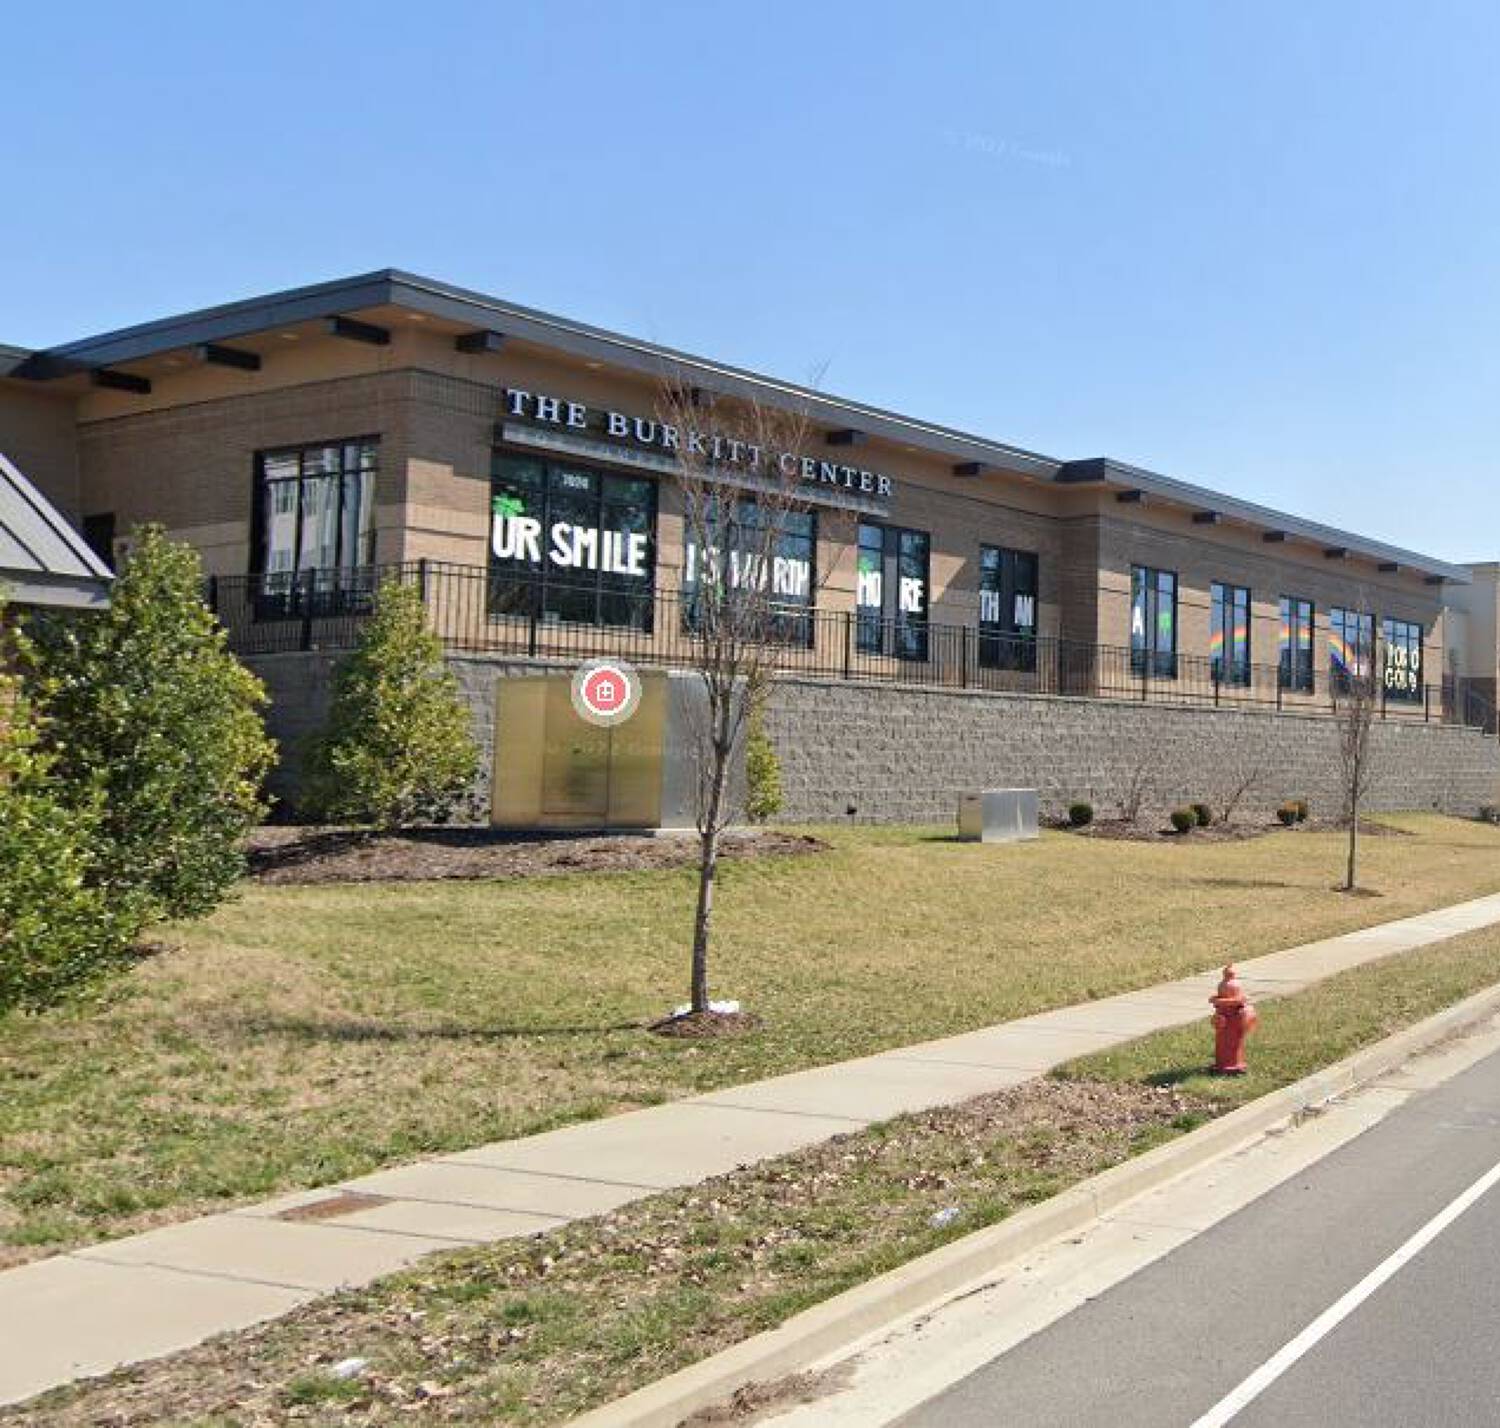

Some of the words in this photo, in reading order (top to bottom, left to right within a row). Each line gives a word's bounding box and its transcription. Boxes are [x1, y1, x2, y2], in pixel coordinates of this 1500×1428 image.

[507, 388, 588, 429] THE
[608, 411, 763, 467] BURKITT
[780, 452, 891, 497] CENTER
[492, 513, 542, 563] UR
[548, 520, 648, 577] SMILE
[1132, 606, 1143, 636] A
